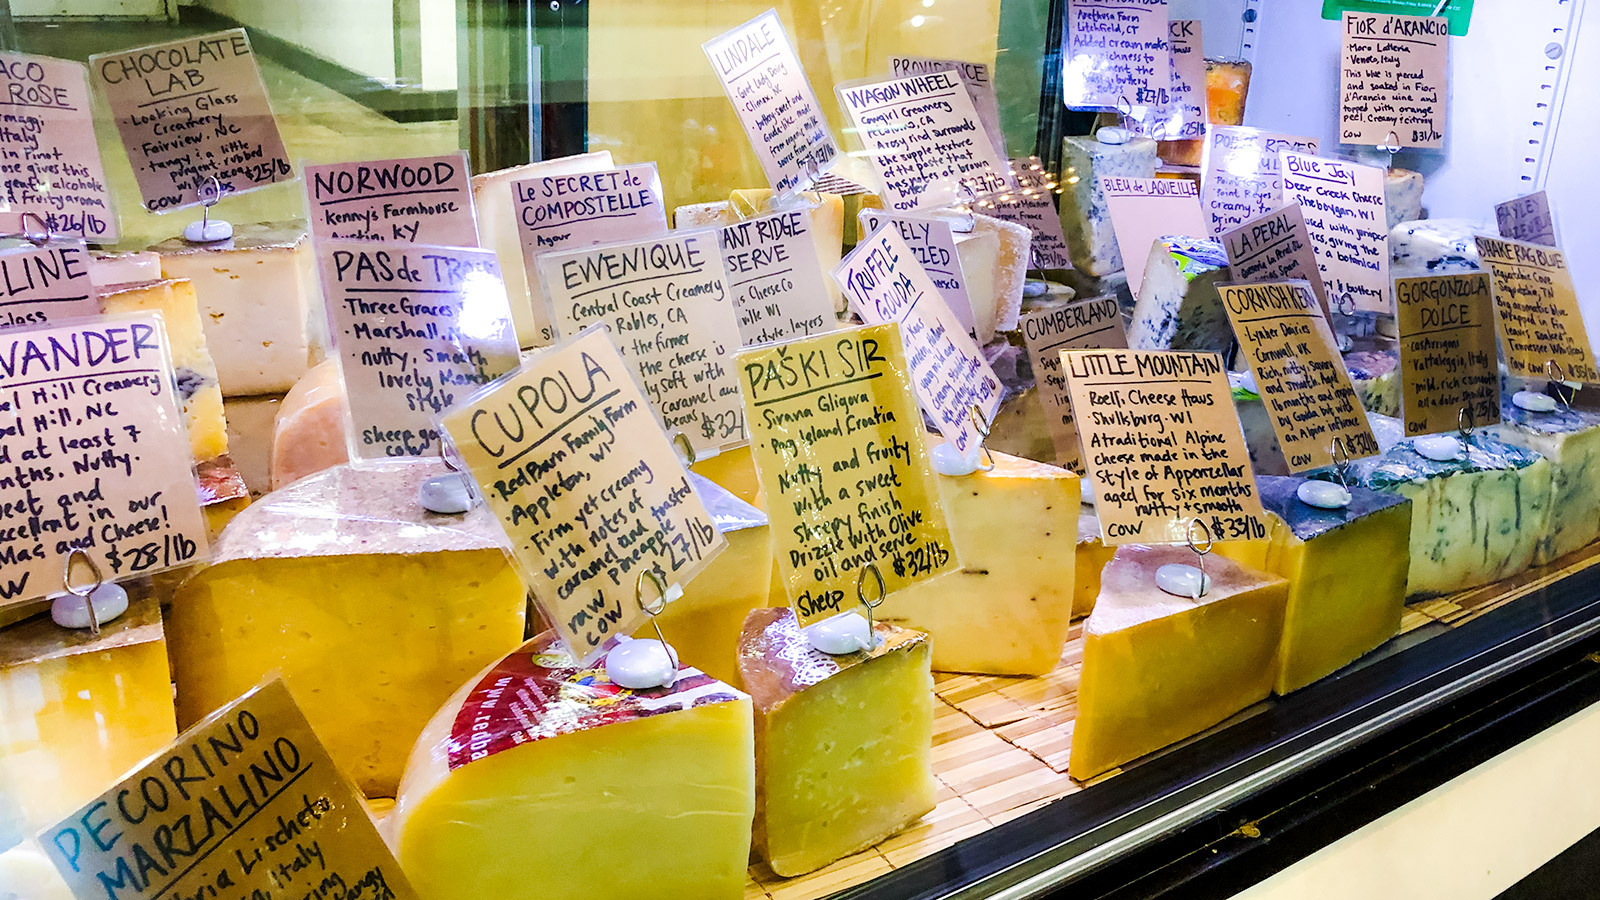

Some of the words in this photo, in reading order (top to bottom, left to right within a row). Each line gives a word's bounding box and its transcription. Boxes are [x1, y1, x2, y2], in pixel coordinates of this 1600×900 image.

[1118, 13, 1139, 22] Farm
[1347, 16, 1376, 34] FIOR
[1383, 17, 1447, 36] d'ARANCIO
[716, 23, 775, 75] LINDALE
[1109, 40, 1142, 50] cream
[102, 37, 249, 84] CHOCOLATE
[1136, 66, 1153, 75] the
[1344, 69, 1361, 77] This
[1381, 55, 1400, 67] Italy
[9, 83, 69, 106] ROSE
[145, 69, 204, 96] LAB
[847, 83, 901, 109] WAGON
[901, 74, 959, 96] WHEEL
[1347, 81, 1364, 90] and
[1415, 83, 1435, 91] Fior
[1136, 88, 1169, 106] $27/lb
[1343, 104, 1368, 112] topped
[1374, 103, 1394, 112] with
[1399, 106, 1433, 117] orange
[1421, 93, 1437, 102] and
[131, 106, 190, 126] Looking
[154, 114, 223, 135] Creamery
[861, 110, 899, 125] Cowgirl
[901, 101, 952, 119] Creamery
[1368, 114, 1396, 126] Creamy
[878, 156, 897, 166] the
[935, 138, 973, 152] texture
[896, 164, 914, 174] the
[918, 157, 944, 173] paste
[946, 150, 973, 164] that
[245, 158, 291, 182] $25/lb
[314, 162, 454, 199] NORWOOD
[959, 160, 990, 174] brown
[1287, 155, 1321, 173] Blue
[1324, 162, 1357, 187] Jay
[517, 183, 535, 203] Le
[542, 173, 620, 198] SECRET
[1133, 182, 1146, 193] de
[1145, 179, 1198, 196] LAQUEILLE
[1352, 190, 1383, 205] Cheese
[325, 206, 379, 231] Kenny's
[384, 202, 459, 219] Farmhouse
[522, 190, 653, 226] COMPOSTELLE
[45, 214, 106, 236] $26/lb
[756, 213, 806, 246] RIDGE
[1231, 234, 1252, 259] LA
[1252, 213, 1297, 246] PERAL
[1329, 223, 1353, 238] with
[537, 232, 571, 246] Agour
[1360, 245, 1379, 256] the
[333, 251, 394, 282] PAS
[562, 238, 705, 290] EWENIQUE
[728, 244, 790, 273] SERVE
[847, 238, 899, 305] TRUFFLE
[1340, 250, 1380, 272] botanical
[1536, 250, 1565, 268] BLUE
[0, 249, 87, 296] LINE
[572, 293, 619, 321] Central
[623, 287, 662, 306] Coast
[667, 279, 725, 301] Creamery
[875, 271, 916, 321] GOUDA
[1227, 285, 1290, 314] CORNISH
[1346, 283, 1382, 301] buttery
[1398, 278, 1489, 305] GORGONZOLA
[345, 298, 398, 316] Three
[400, 298, 452, 317] Graces
[1027, 299, 1118, 341] CUMBERLAND
[1421, 304, 1471, 328] DOLCE
[0, 324, 158, 379] VANDER
[632, 337, 653, 356] the
[640, 361, 662, 378] the
[669, 347, 707, 368] cheese
[744, 345, 830, 399] PAŠKI
[836, 339, 886, 378] SIR
[1067, 353, 1134, 378] LITTLE
[1136, 352, 1222, 378] MOUNTAIN
[83, 374, 161, 396] Creamery
[379, 368, 433, 392] lovely
[1265, 382, 1284, 394] and
[86, 402, 118, 419] NC
[406, 388, 454, 413] style
[471, 351, 611, 459] CUPOLA
[661, 385, 716, 415] caramel
[1129, 389, 1176, 406] Cheese
[602, 400, 638, 440] Farm
[846, 406, 897, 435] Croatia
[59, 428, 115, 455] least
[1185, 431, 1226, 448] Alpine
[832, 448, 860, 474] and
[866, 438, 910, 466] fruity
[1094, 451, 1136, 465] cheese
[1140, 448, 1178, 462] made
[1202, 448, 1229, 461] the
[58, 478, 105, 508] and
[856, 467, 901, 496] sweet
[1103, 487, 1137, 508] aged
[1200, 481, 1252, 499] months
[128, 492, 162, 512] our
[511, 470, 591, 526] Appleton,
[530, 519, 573, 556] Firm
[575, 498, 599, 529] yet
[600, 459, 654, 504] creamy
[857, 490, 902, 521] finish
[1193, 499, 1243, 514] smooth
[56, 526, 96, 554] and
[101, 506, 171, 543] Cheese!
[1210, 515, 1266, 540] $33/lb
[105, 533, 196, 574] $28/lb
[543, 542, 585, 579] with
[588, 507, 627, 547] notes
[651, 517, 714, 588] $27/lb
[790, 538, 843, 569] Drizzle
[556, 544, 618, 600] caramel
[617, 519, 649, 549] and
[814, 559, 838, 582] oil
[841, 545, 876, 571] and
[879, 532, 917, 557] serve
[892, 541, 949, 579] $32/lb
[52, 709, 261, 873] PECORINO
[96, 736, 300, 900] MARZALINO
[235, 794, 331, 875] Lischeto
[270, 839, 324, 889] Italy
